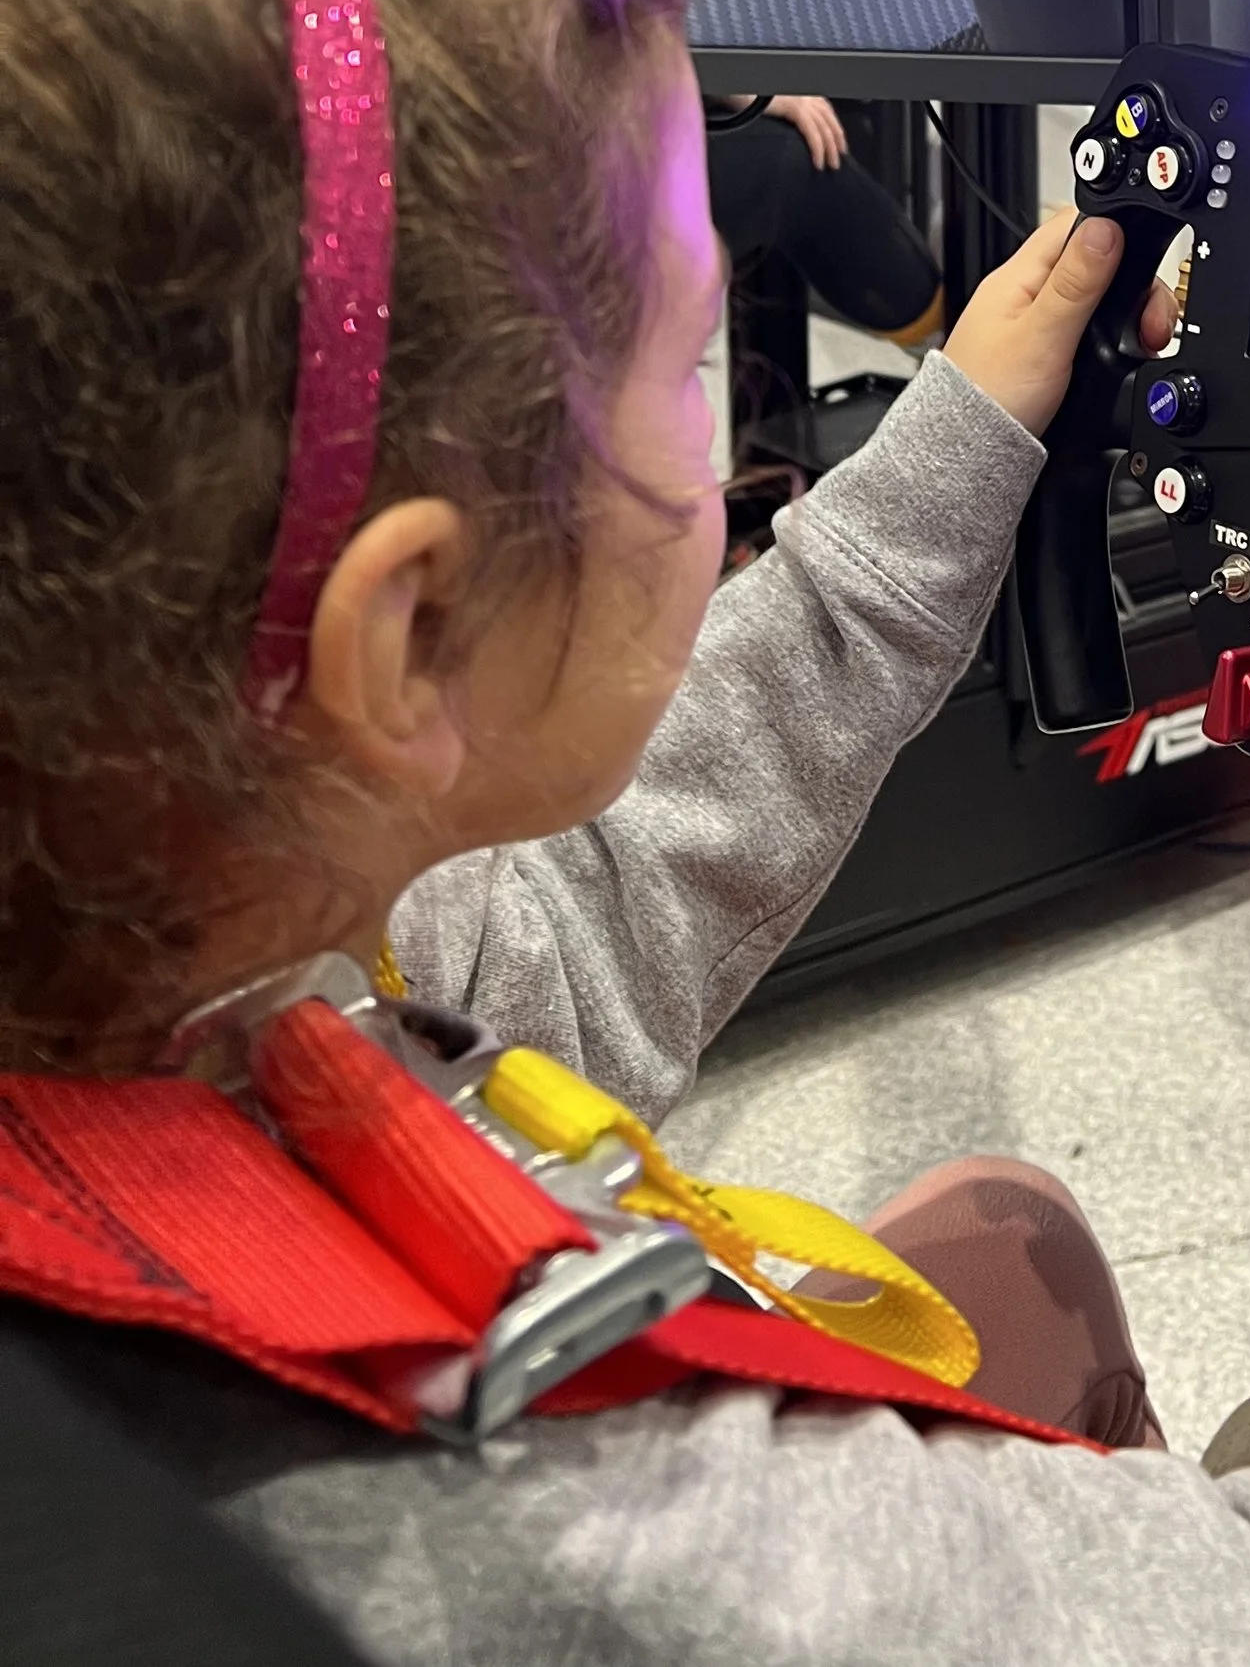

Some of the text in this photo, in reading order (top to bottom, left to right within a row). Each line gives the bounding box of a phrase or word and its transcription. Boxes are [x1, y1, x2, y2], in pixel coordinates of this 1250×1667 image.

[1131, 102, 1143, 118] B
[1083, 152, 1094, 169] N
[1157, 152, 1168, 183] APP
[1160, 479, 1178, 501] LL
[1215, 524, 1248, 549] TRC
